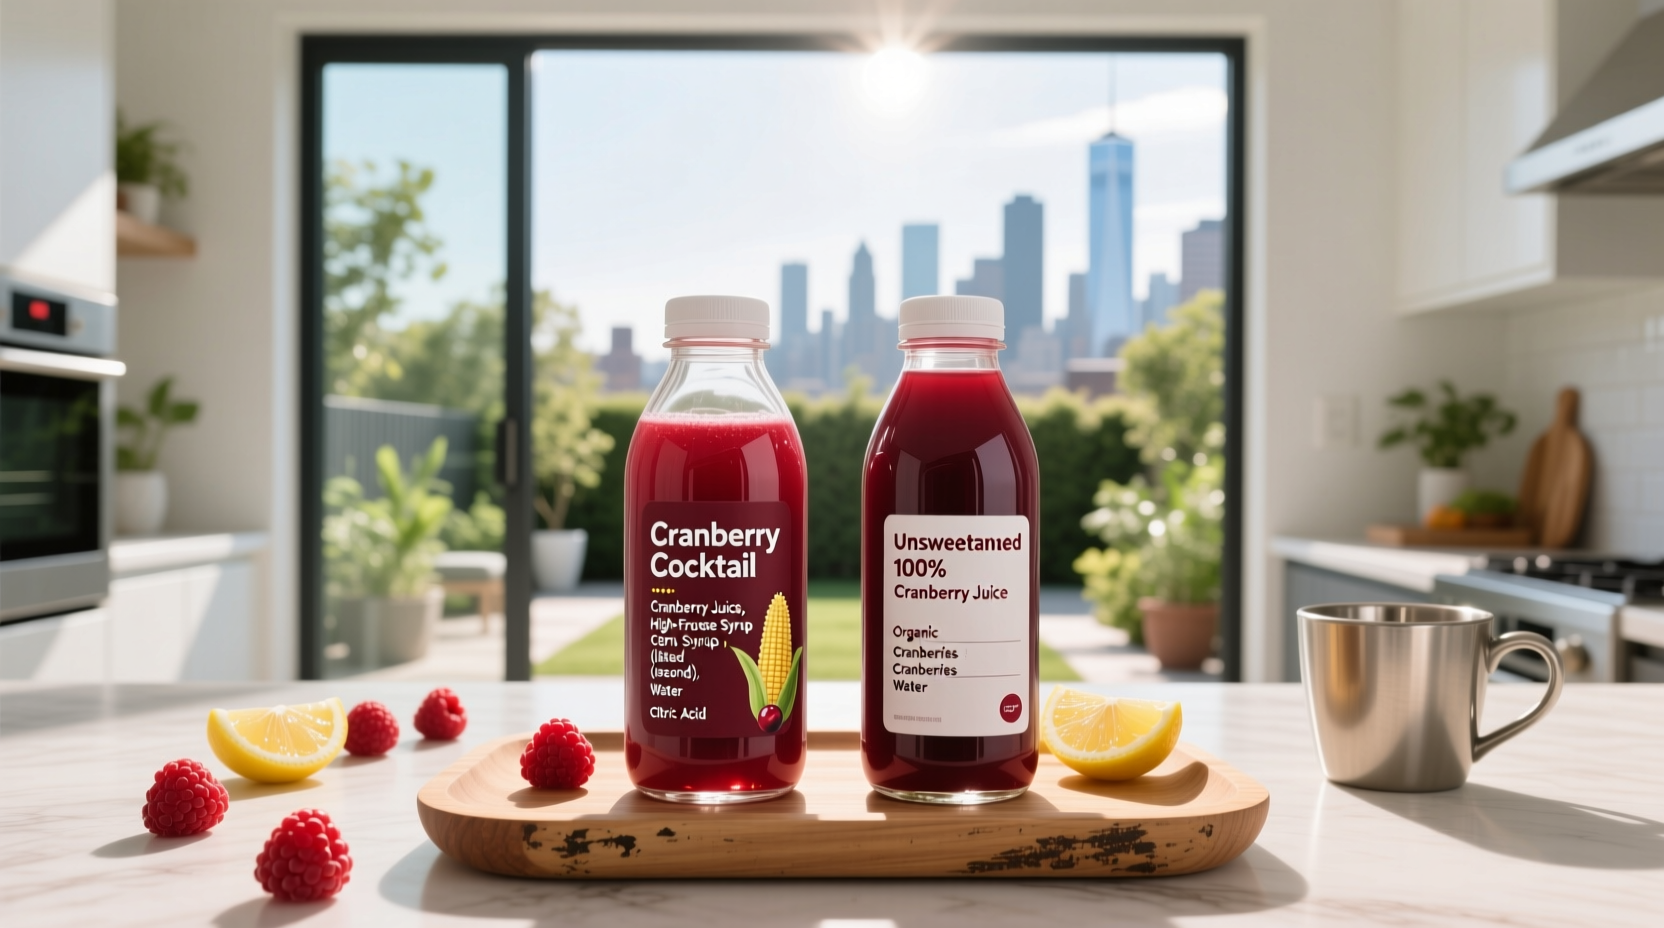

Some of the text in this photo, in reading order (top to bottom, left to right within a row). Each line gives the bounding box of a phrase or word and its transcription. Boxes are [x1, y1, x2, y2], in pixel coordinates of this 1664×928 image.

[650, 521, 781, 554] Cranberry
[650, 551, 757, 578] Cocktail
[893, 558, 947, 578] 100%
[894, 584, 1009, 603] Cranberry Juice
[892, 625, 939, 642] Organic
[650, 683, 683, 697] Water
[893, 679, 928, 693] Water
[680, 707, 707, 720] Acid
